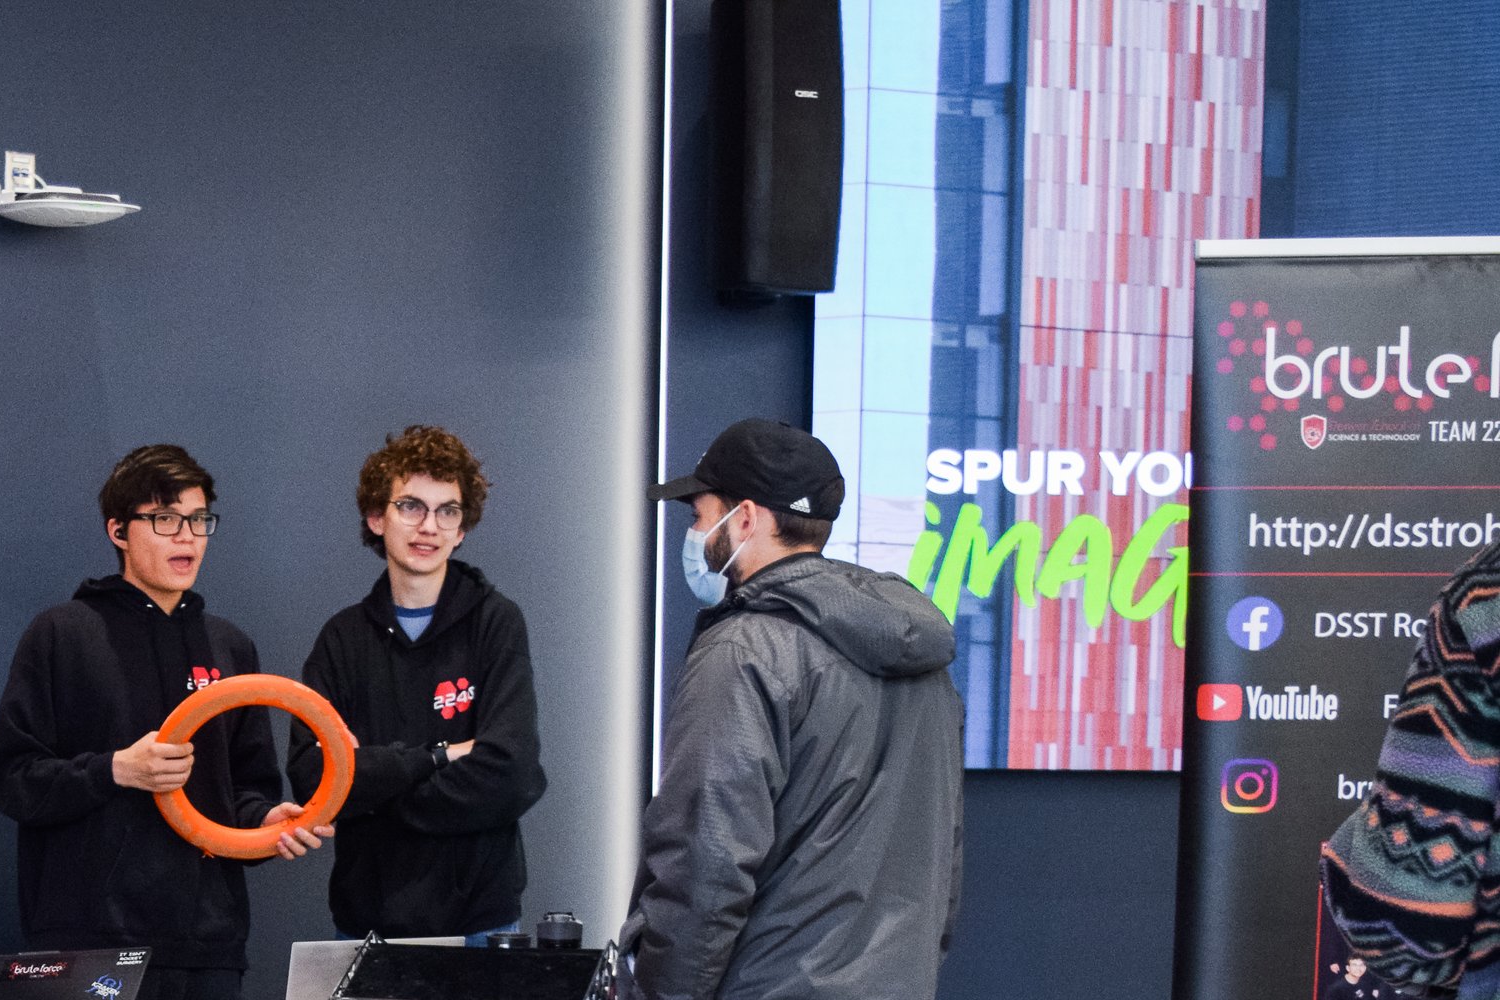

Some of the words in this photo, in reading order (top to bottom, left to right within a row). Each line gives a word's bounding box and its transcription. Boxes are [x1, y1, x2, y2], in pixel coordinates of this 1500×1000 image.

[1265, 325, 1472, 399] brute
[1328, 433, 1359, 442] SCIENCE
[1369, 433, 1421, 442] TECHNOLOGY
[1428, 421, 1476, 442] TEAM
[926, 449, 1087, 496] SPUR
[1098, 450, 1193, 498] YO
[1314, 612, 1388, 638] DSST
[1246, 685, 1338, 721] YouTube
[1337, 773, 1373, 800] br
